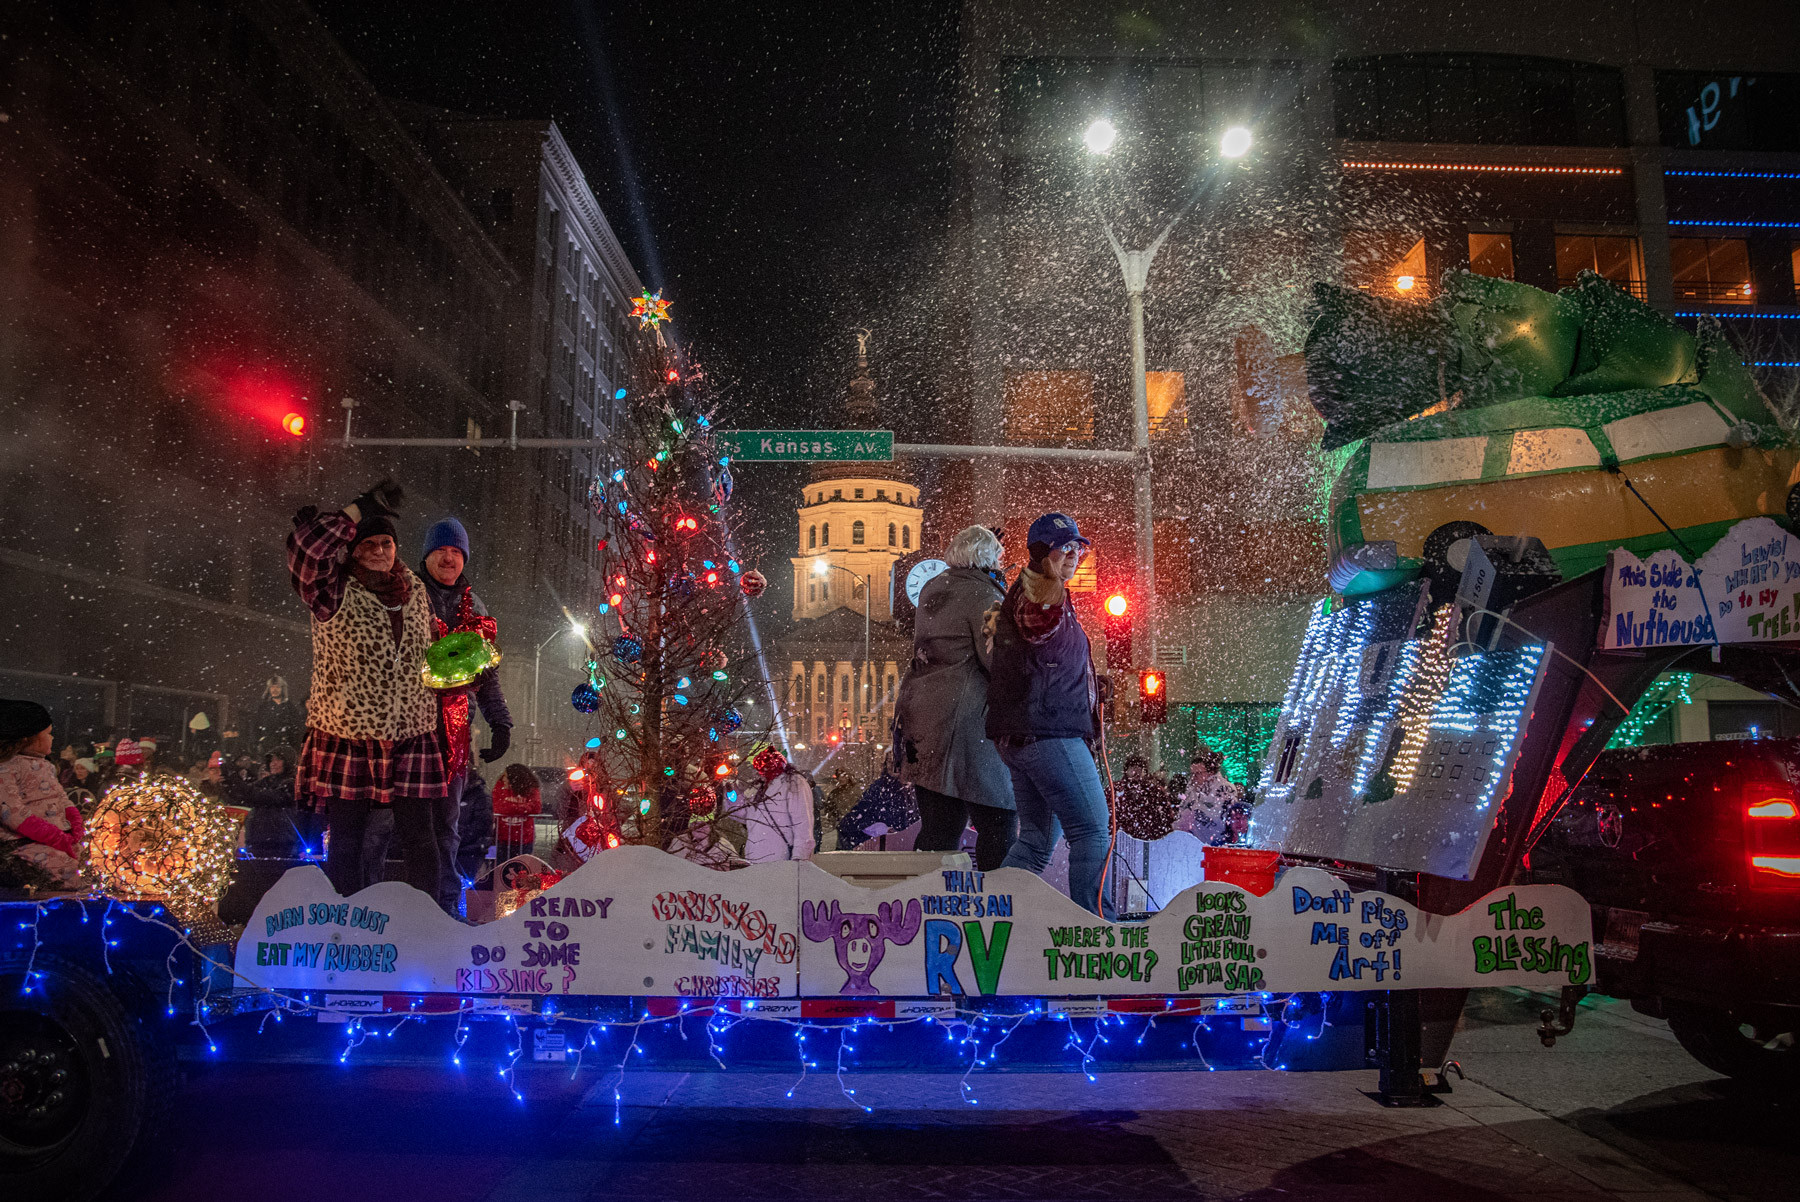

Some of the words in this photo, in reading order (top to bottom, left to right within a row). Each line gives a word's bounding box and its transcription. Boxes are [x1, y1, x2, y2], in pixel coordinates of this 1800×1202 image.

[760, 438, 835, 454] Kansas
[1619, 564, 1647, 588] This
[1649, 559, 1683, 589] Side
[1651, 588, 1677, 611] the
[1738, 589, 1753, 609] to
[942, 870, 985, 894] THAT
[530, 895, 613, 919] READY
[921, 895, 985, 918] THERE'S
[986, 894, 1013, 917] AN
[1196, 890, 1247, 914] LOOKS
[1291, 885, 1355, 915] Don't
[1487, 891, 1546, 931] The
[265, 905, 305, 937] BURN
[307, 902, 350, 927] SOME
[350, 905, 390, 935] DUST
[524, 920, 569, 941] TO
[651, 890, 797, 965] GRISWOLD
[1183, 913, 1252, 942] GREAT!
[664, 923, 764, 979] FAMILY
[1047, 925, 1116, 949] WHERE'S
[1119, 925, 1150, 949] THE
[256, 941, 292, 967] EAT
[292, 942, 324, 968] MY
[323, 943, 399, 974] RUBBER
[471, 944, 506, 966] DO
[521, 942, 580, 967] SOME
[924, 918, 1013, 998] RV
[1043, 948, 1159, 983] TYLENOL?
[1181, 939, 1222, 966] LITTLE
[1222, 938, 1256, 964] FULL
[1328, 948, 1402, 983] Art!
[673, 974, 781, 998] CHRISTMAS
[1177, 960, 1224, 992] LOTTA
[1224, 961, 1265, 991] SAP
